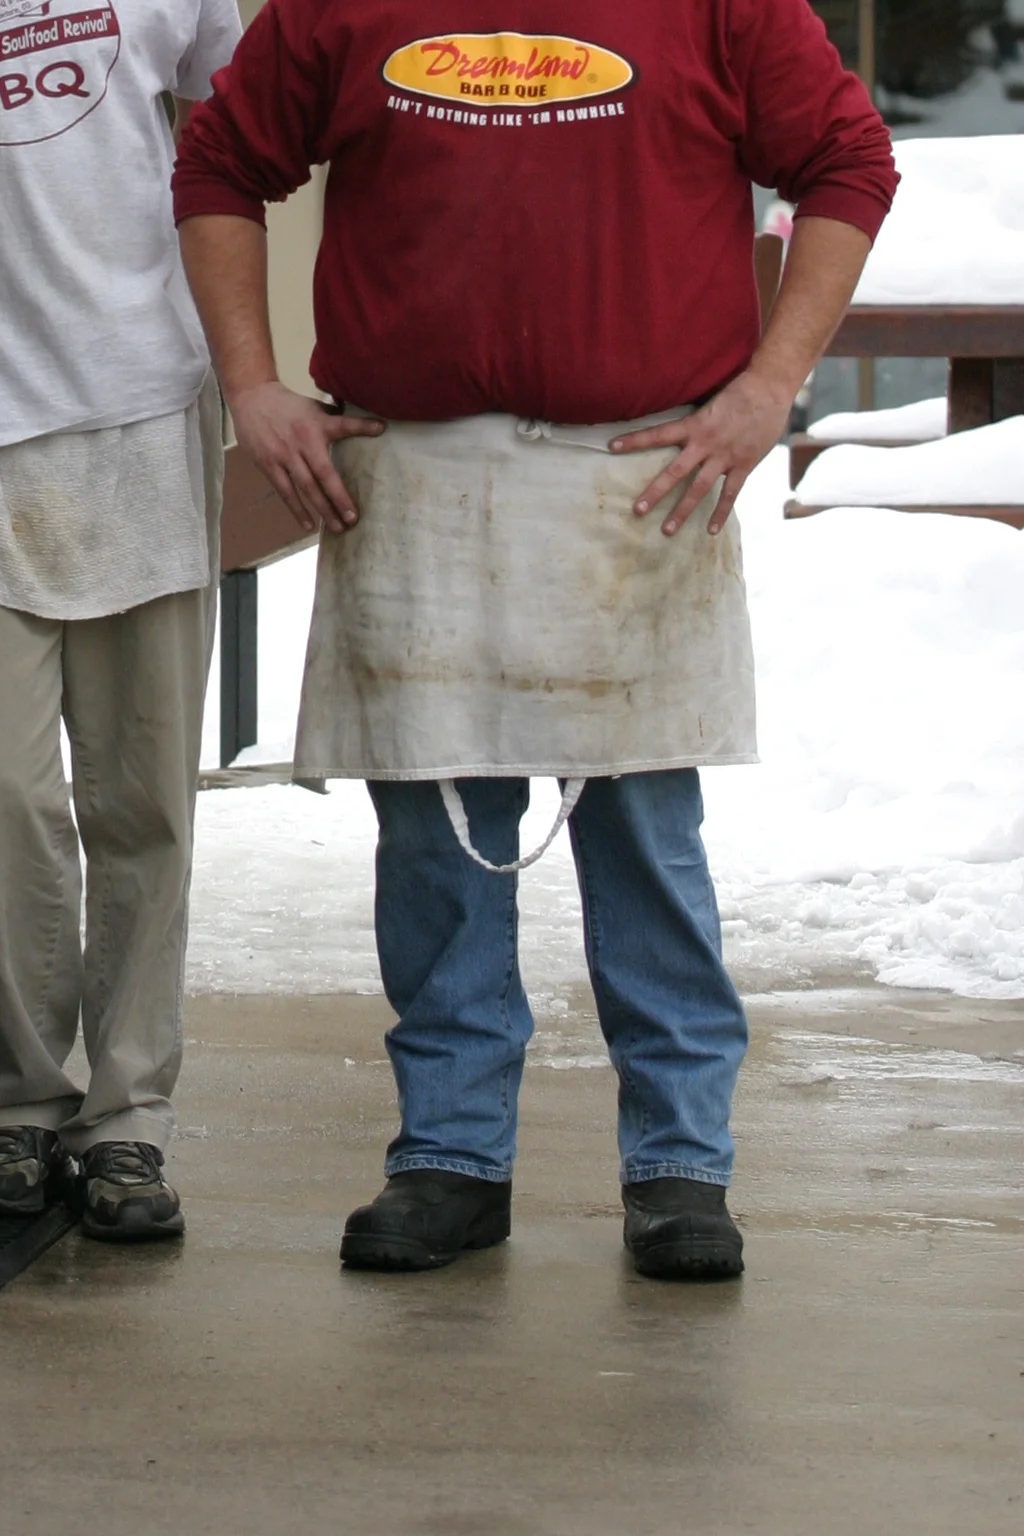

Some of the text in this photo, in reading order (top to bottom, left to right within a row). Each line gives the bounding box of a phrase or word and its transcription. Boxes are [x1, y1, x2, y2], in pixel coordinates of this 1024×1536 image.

[1, 23, 59, 55] Soulfood
[420, 40, 591, 81] Dreamland
[459, 82, 548, 98] BAR B QUE
[387, 95, 626, 127] AIN'T NOTHING LIKE 'EM NOWHERE
